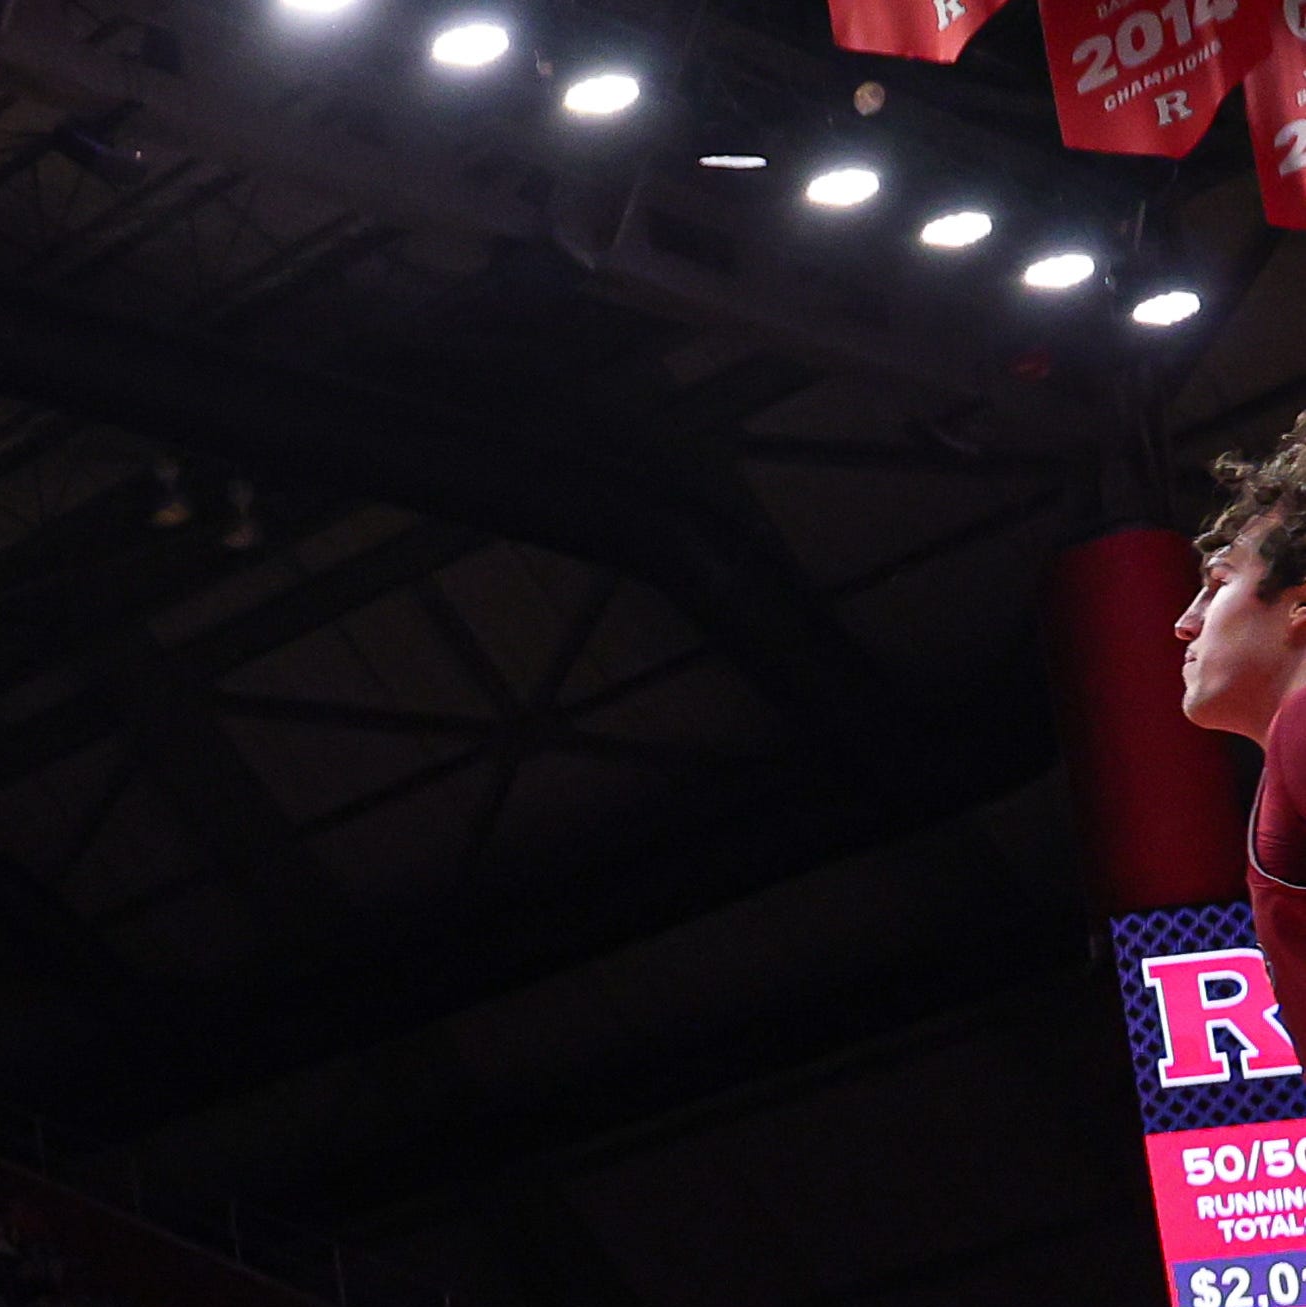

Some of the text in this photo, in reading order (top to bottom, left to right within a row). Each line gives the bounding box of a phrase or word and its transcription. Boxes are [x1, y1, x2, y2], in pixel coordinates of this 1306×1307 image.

[1071, 0, 1236, 95] 2014
[1154, 90, 1193, 126] R
[1141, 948, 1303, 1089] R
[1196, 1186, 1306, 1220] RUNNIN
[1217, 1213, 1306, 1243] TOTAL
